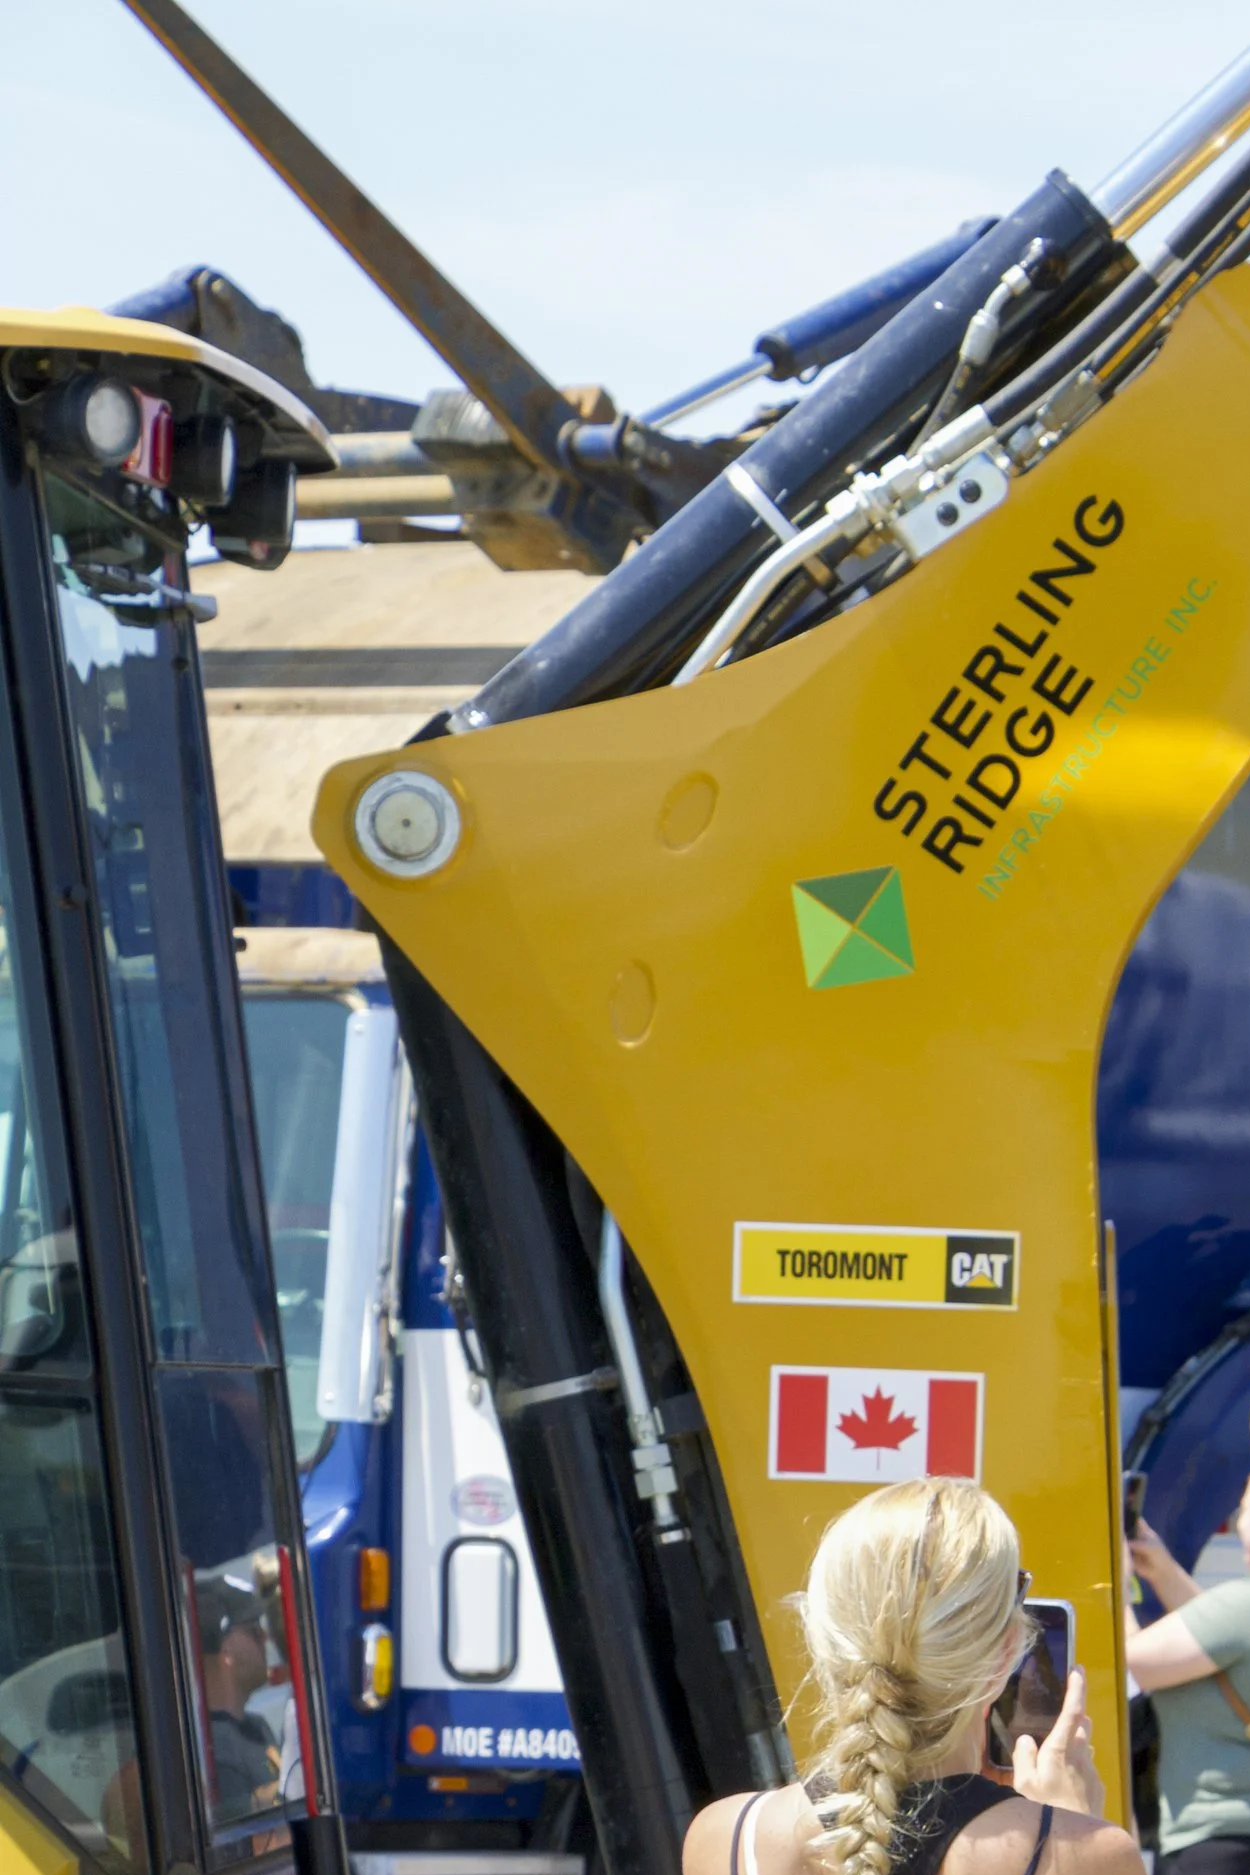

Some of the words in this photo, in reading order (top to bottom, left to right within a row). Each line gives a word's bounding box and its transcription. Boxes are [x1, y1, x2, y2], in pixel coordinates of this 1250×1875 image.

[873, 494, 1125, 837] STERLING
[921, 653, 1095, 875] RIDGE
[977, 636, 1172, 900] INFRASTRUCTURE
[1163, 576, 1218, 634] INC.
[776, 1249, 908, 1281] TOROMONT
[951, 1251, 1009, 1289] CAT
[442, 1726, 494, 1758] MOE
